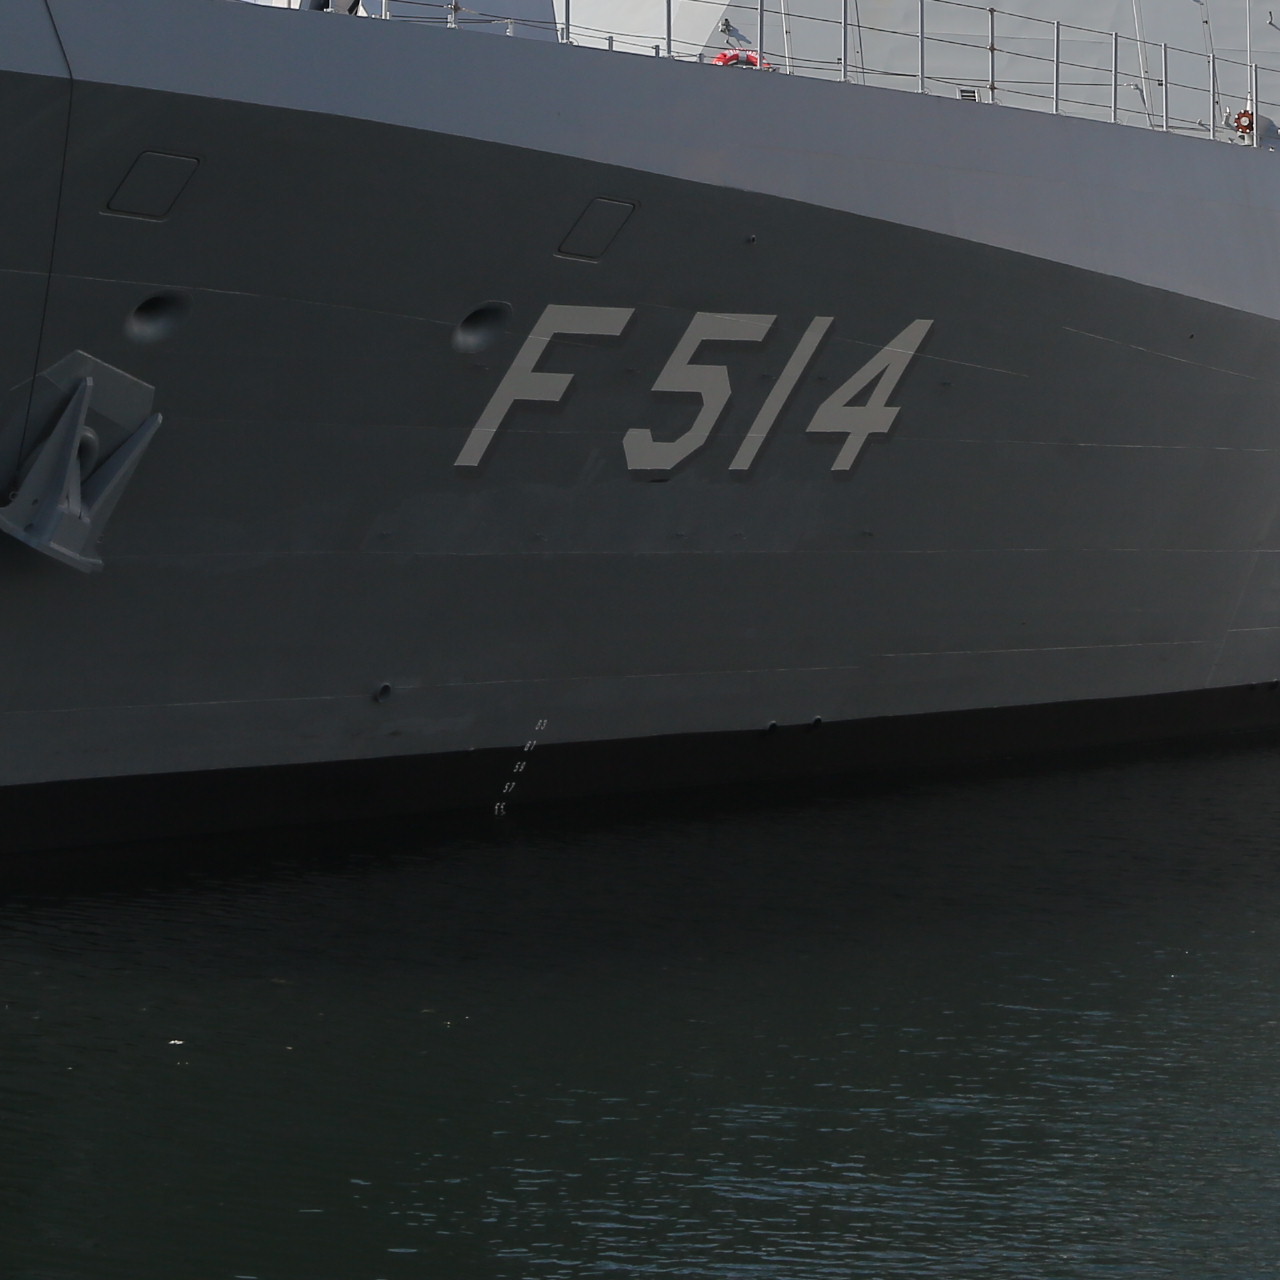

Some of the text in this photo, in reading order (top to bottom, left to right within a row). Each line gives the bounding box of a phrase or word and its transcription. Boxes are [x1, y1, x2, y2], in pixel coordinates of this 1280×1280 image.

[453, 304, 935, 471] F 514
[503, 782, 516, 793] 57
